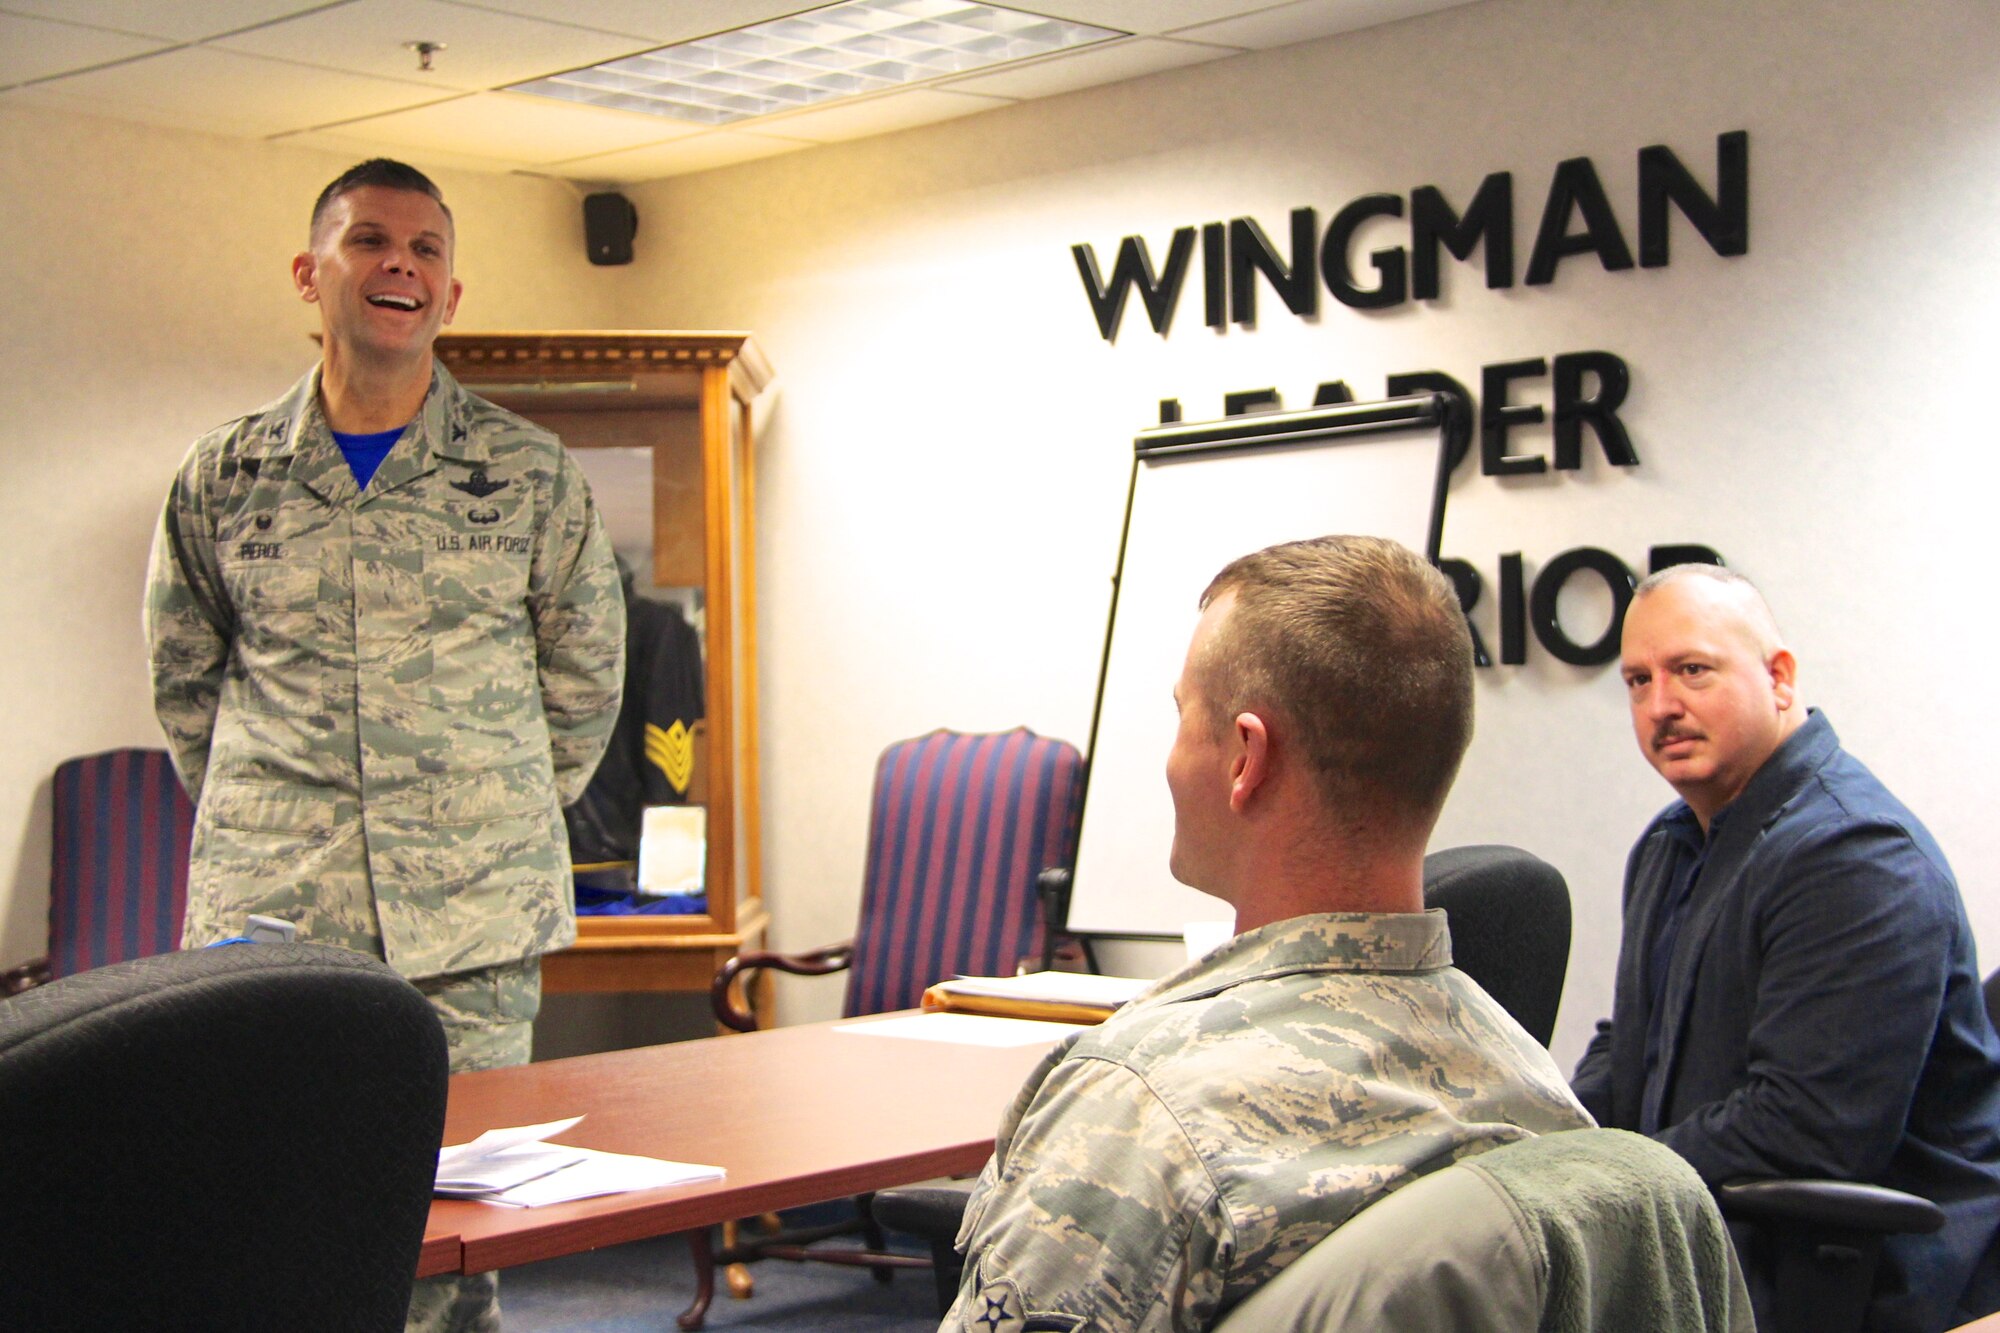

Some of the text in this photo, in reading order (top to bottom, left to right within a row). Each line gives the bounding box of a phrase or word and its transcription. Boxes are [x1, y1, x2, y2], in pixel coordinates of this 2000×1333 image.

[1071, 131, 1748, 340] WINGMAN
[436, 535, 464, 551] U.S.
[469, 535, 492, 550] AIR
